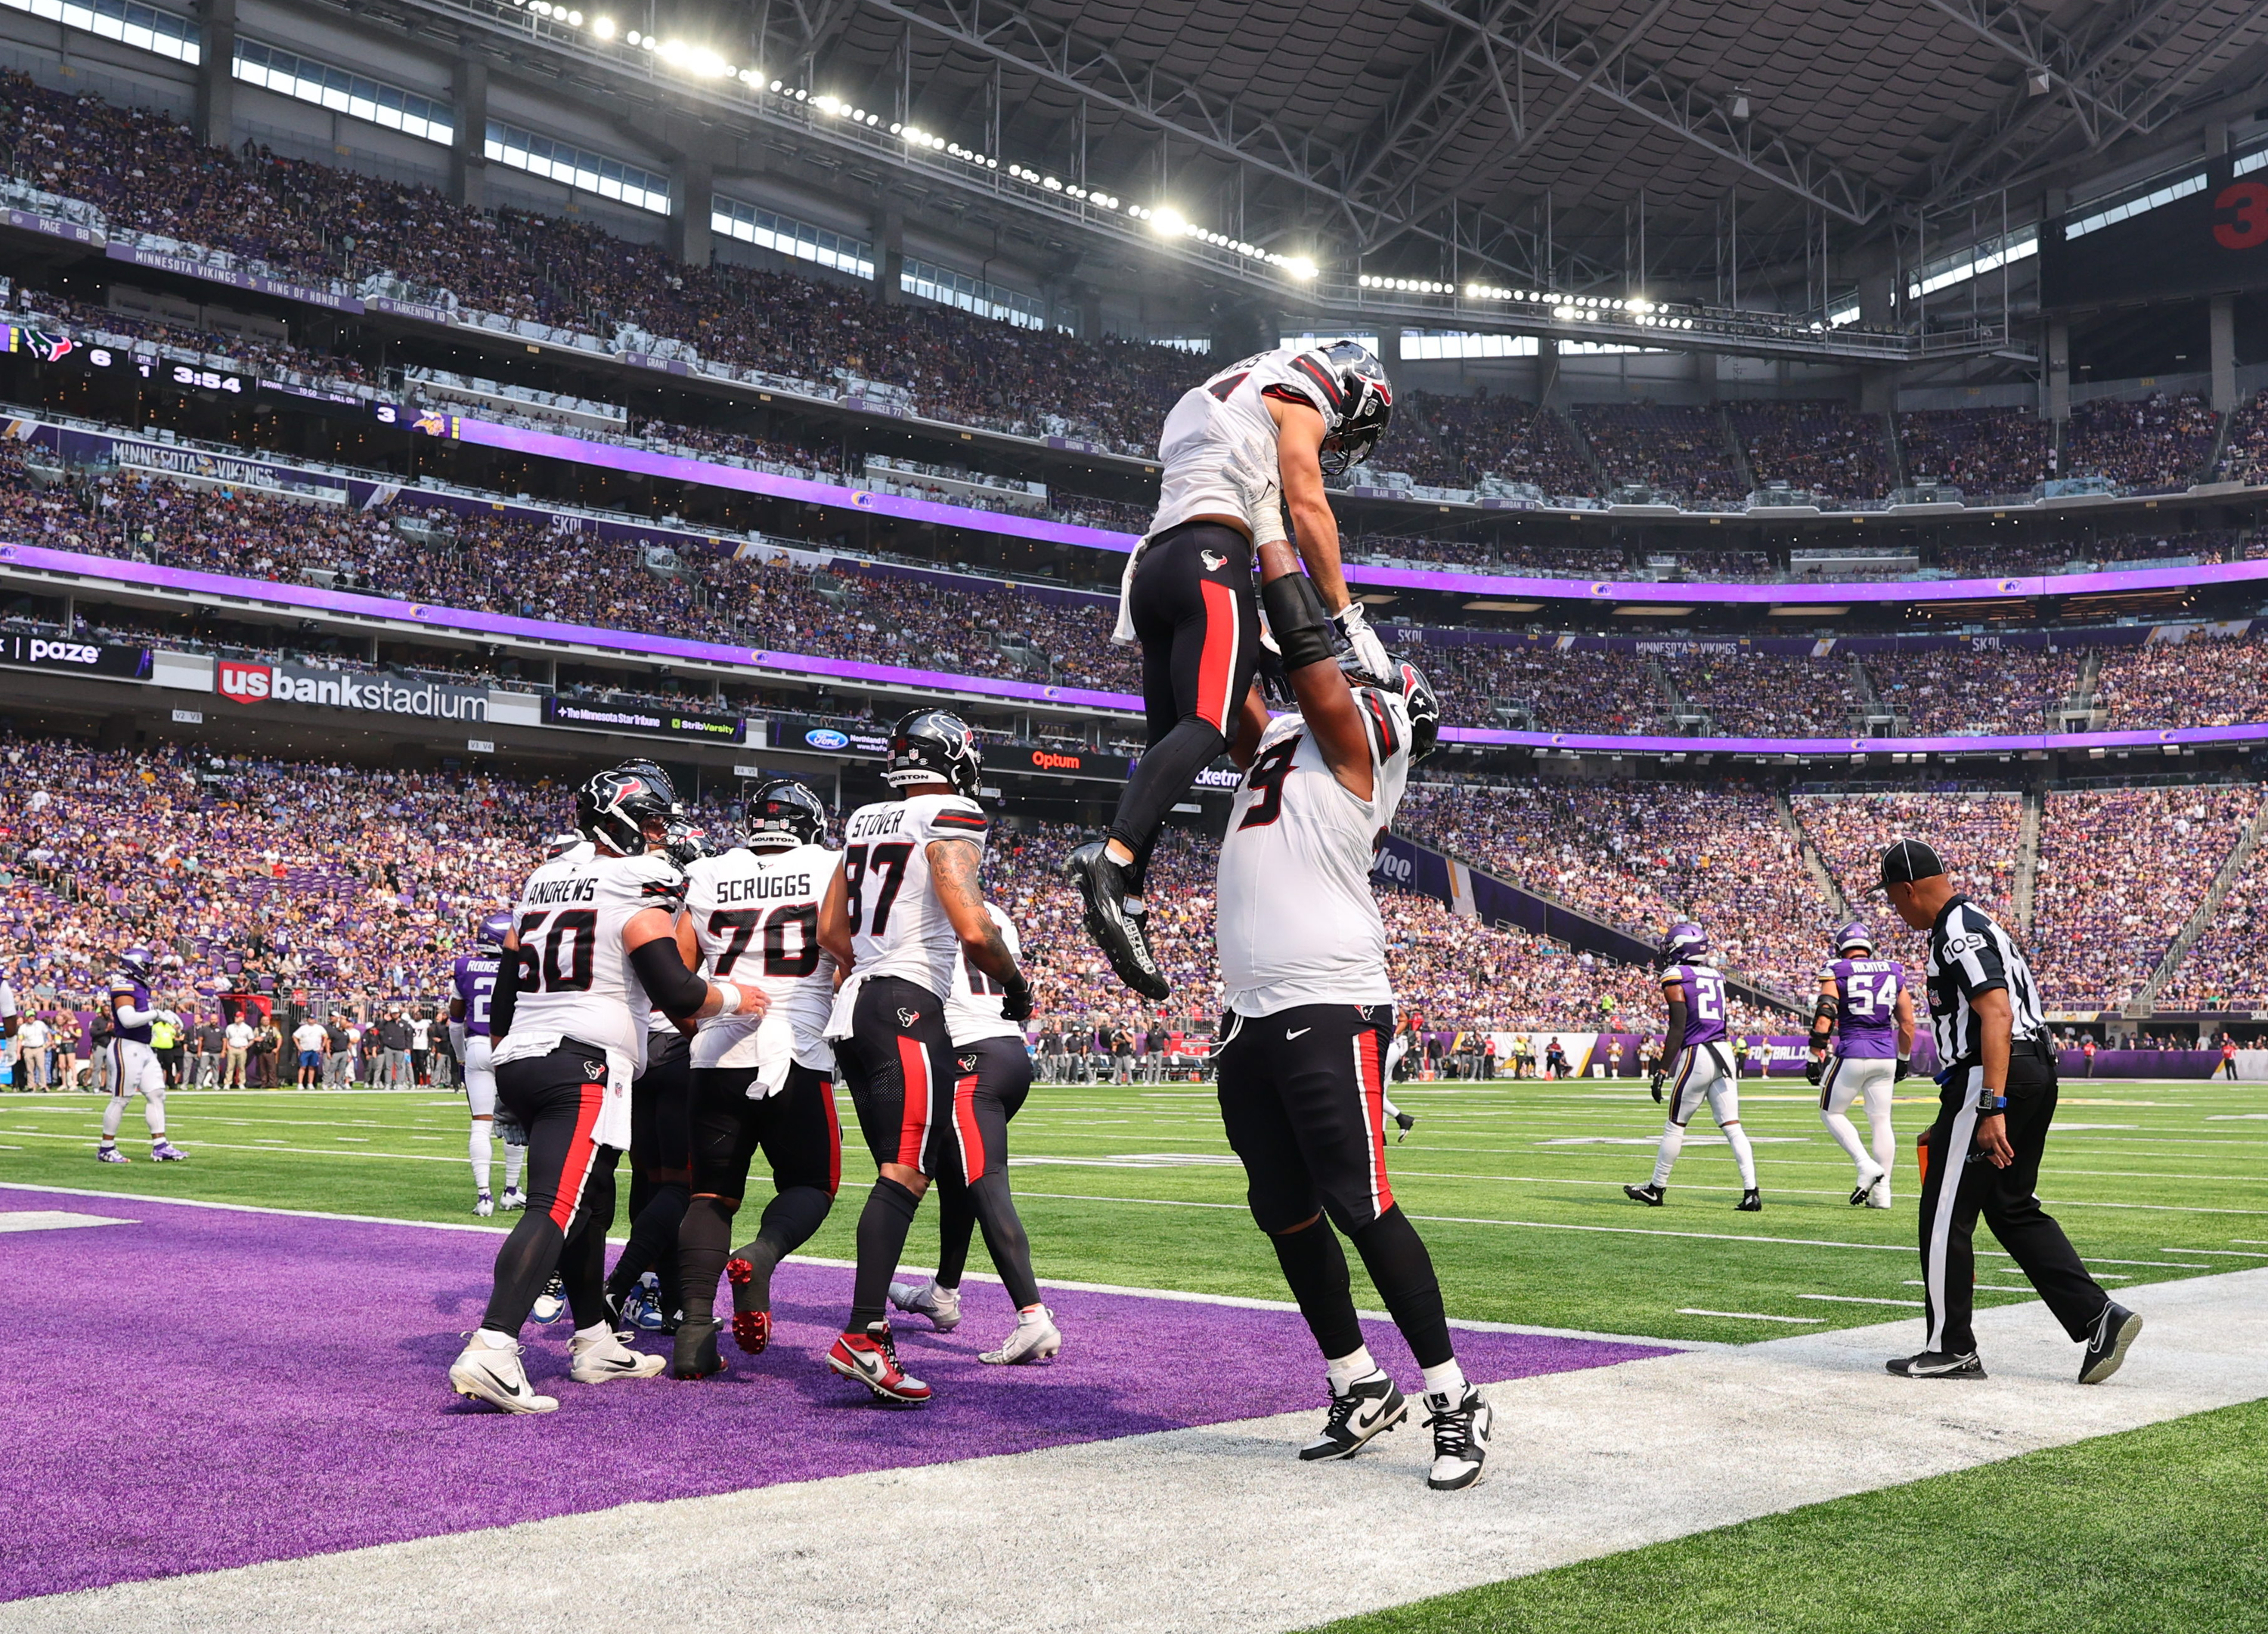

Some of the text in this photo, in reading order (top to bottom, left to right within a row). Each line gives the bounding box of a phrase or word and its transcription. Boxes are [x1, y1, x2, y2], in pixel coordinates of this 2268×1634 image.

[2213, 182, 2268, 250] 3
[39, 218, 89, 241] PAGE 88
[135, 250, 339, 307] MINNESOTA VIKINGS RING OF HONOR
[392, 302, 445, 321] TARKENTON 10
[89, 348, 112, 367] 6
[137, 353, 151, 364] QTR
[646, 357, 668, 370] GRANT
[138, 364, 150, 378] 1
[173, 366, 241, 393] 3:54
[262, 379, 355, 404] DOWN TO GO BALL ON
[376, 406, 396, 423] 3
[862, 401, 903, 416] STRINGER 77
[1064, 440, 1099, 453] BROWN 30
[112, 441, 274, 487] MINNESOTA VIKINGS
[1372, 489, 1389, 498] BLAIR
[1498, 500, 1522, 509] JORDAN
[29, 638, 99, 664] paze
[1635, 642, 1688, 655] MINNESOTA
[1700, 642, 1737, 655] VIKINGS
[222, 668, 269, 698] us
[175, 711, 200, 721] V2 V3
[567, 707, 580, 719] The
[580, 709, 618, 723] Minnesota
[470, 741, 493, 750] V3 V4
[813, 732, 840, 747] Ford
[850, 734, 881, 744] Northland
[1032, 750, 1080, 769] Optum
[851, 809, 906, 838] STOVER
[528, 877, 600, 907] ANDREWS
[717, 874, 811, 905] SCRUGGS
[844, 842, 916, 937] 87
[707, 901, 820, 978] 70
[1943, 934, 1981, 960] 109
[1851, 961, 1892, 973] RICHTER
[473, 976, 497, 1023] 2
[1696, 976, 1727, 1022] 21
[1847, 974, 1897, 1017] 54
